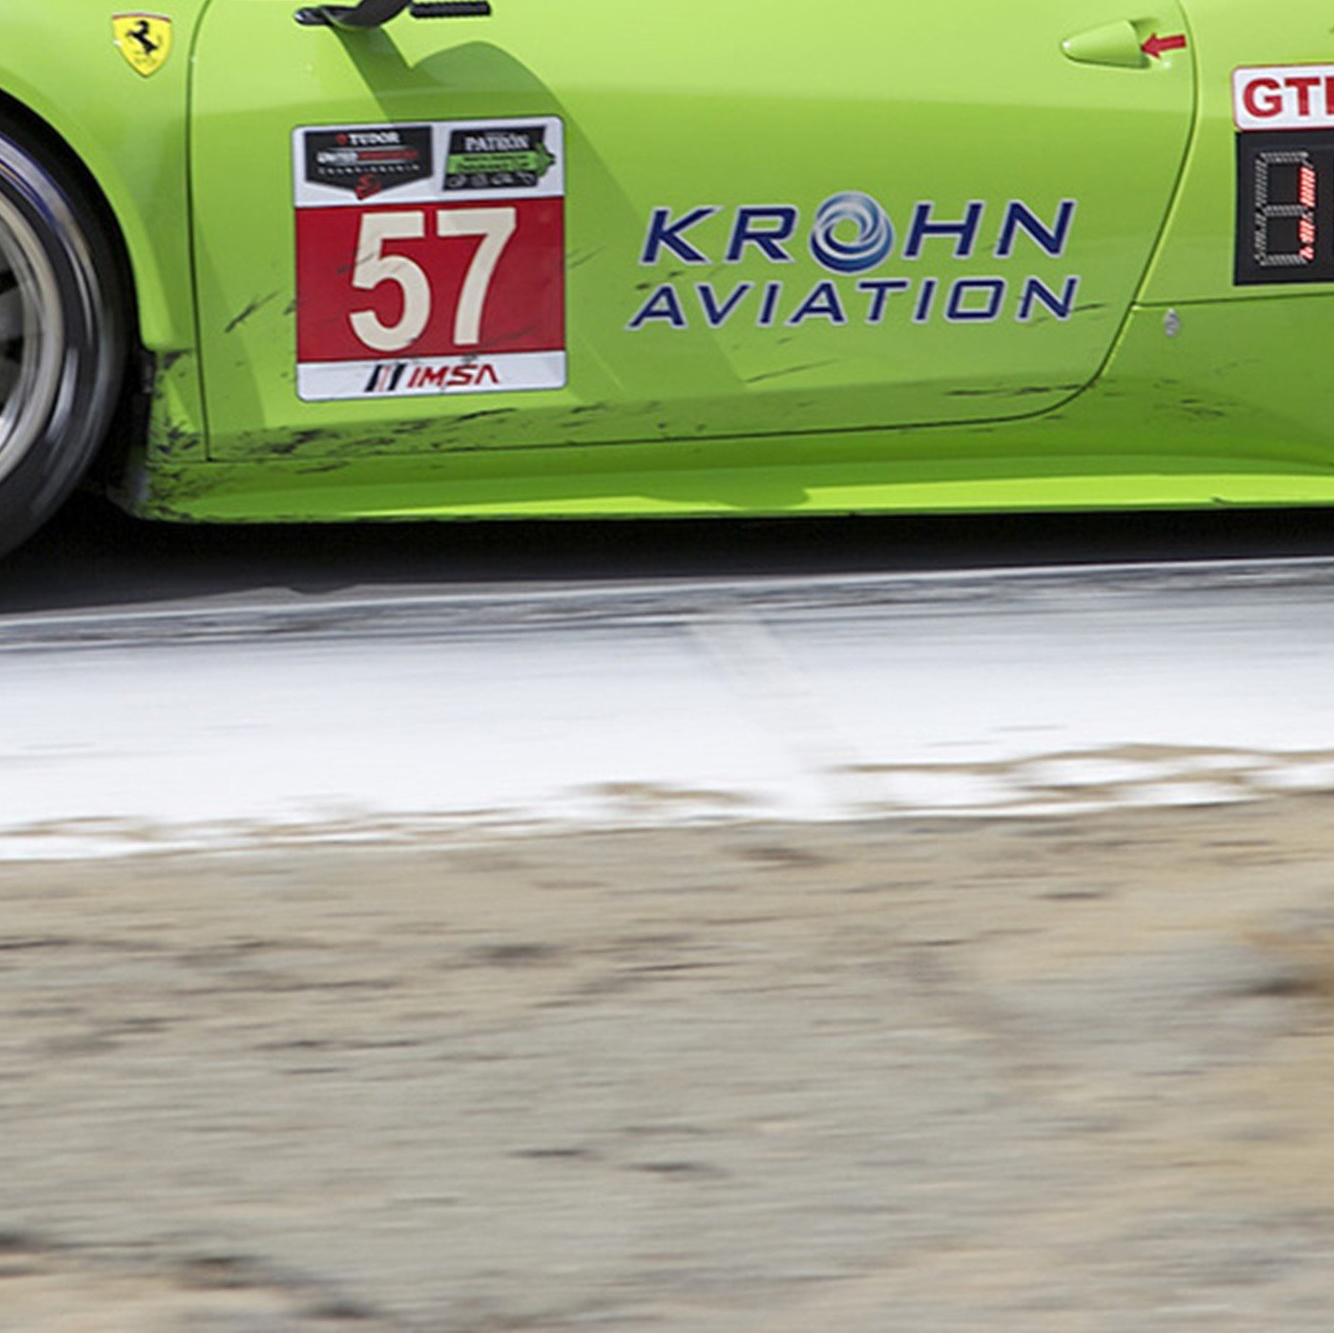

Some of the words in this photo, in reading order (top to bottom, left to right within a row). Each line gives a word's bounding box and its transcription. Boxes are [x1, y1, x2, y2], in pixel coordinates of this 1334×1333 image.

[639, 190, 1077, 275] KROHN
[348, 206, 517, 353] 57
[624, 276, 1080, 331] AVIATION
[407, 364, 499, 388] IMSA
